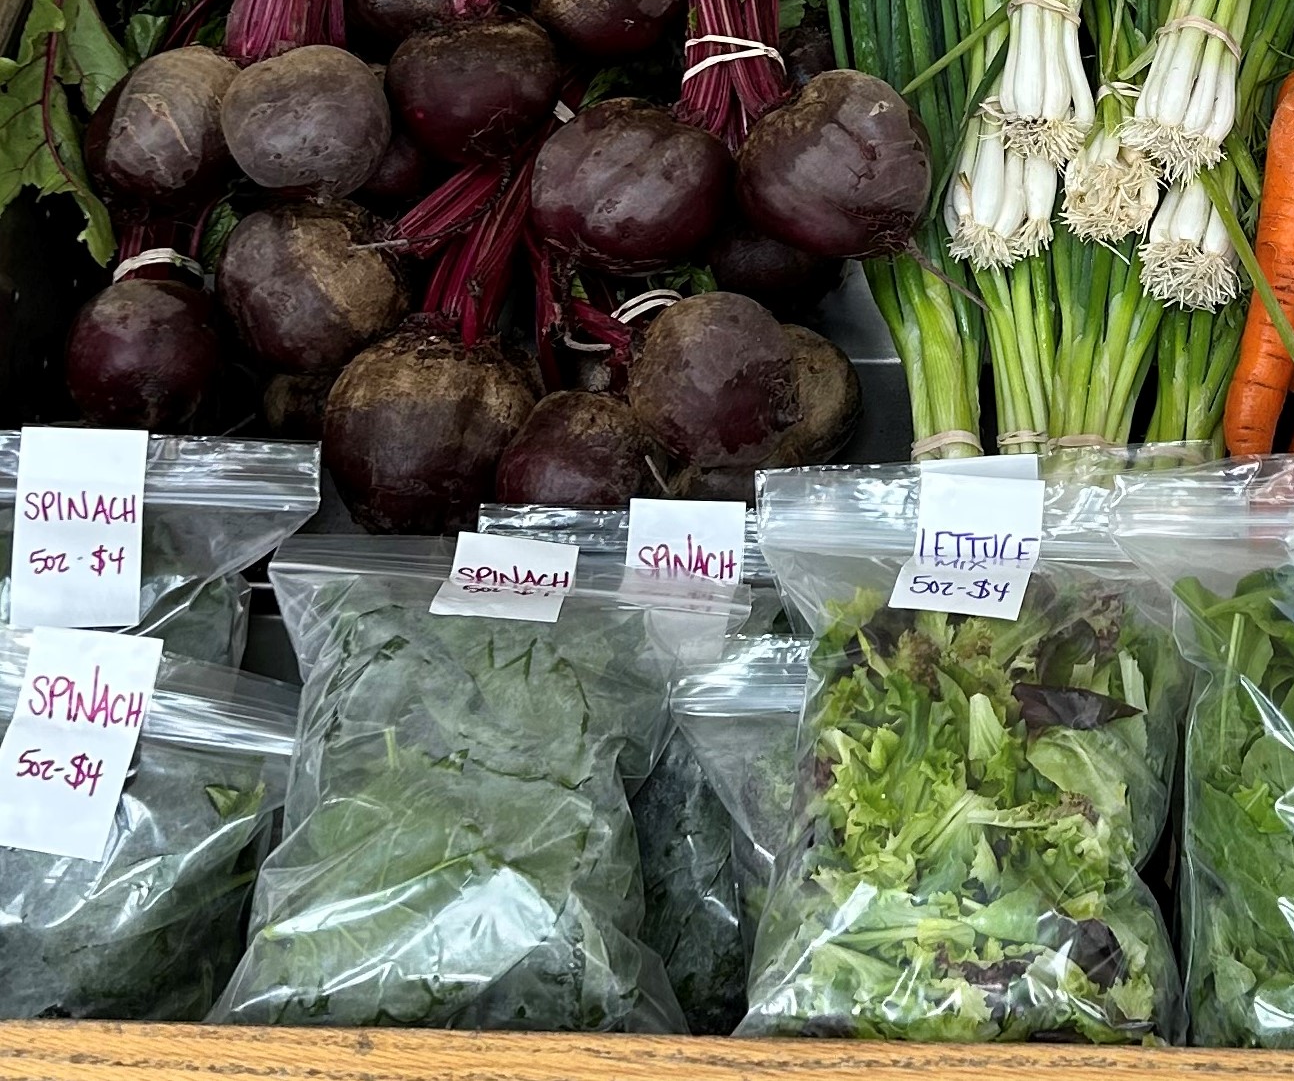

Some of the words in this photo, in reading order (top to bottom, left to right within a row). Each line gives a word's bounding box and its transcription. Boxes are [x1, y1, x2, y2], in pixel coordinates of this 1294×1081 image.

[24, 490, 136, 525] SPINACH
[636, 534, 738, 580] SPINACH
[919, 528, 1040, 562] LETTUCE
[457, 565, 569, 589] SPINACH
[28, 665, 143, 728] SPINACH
